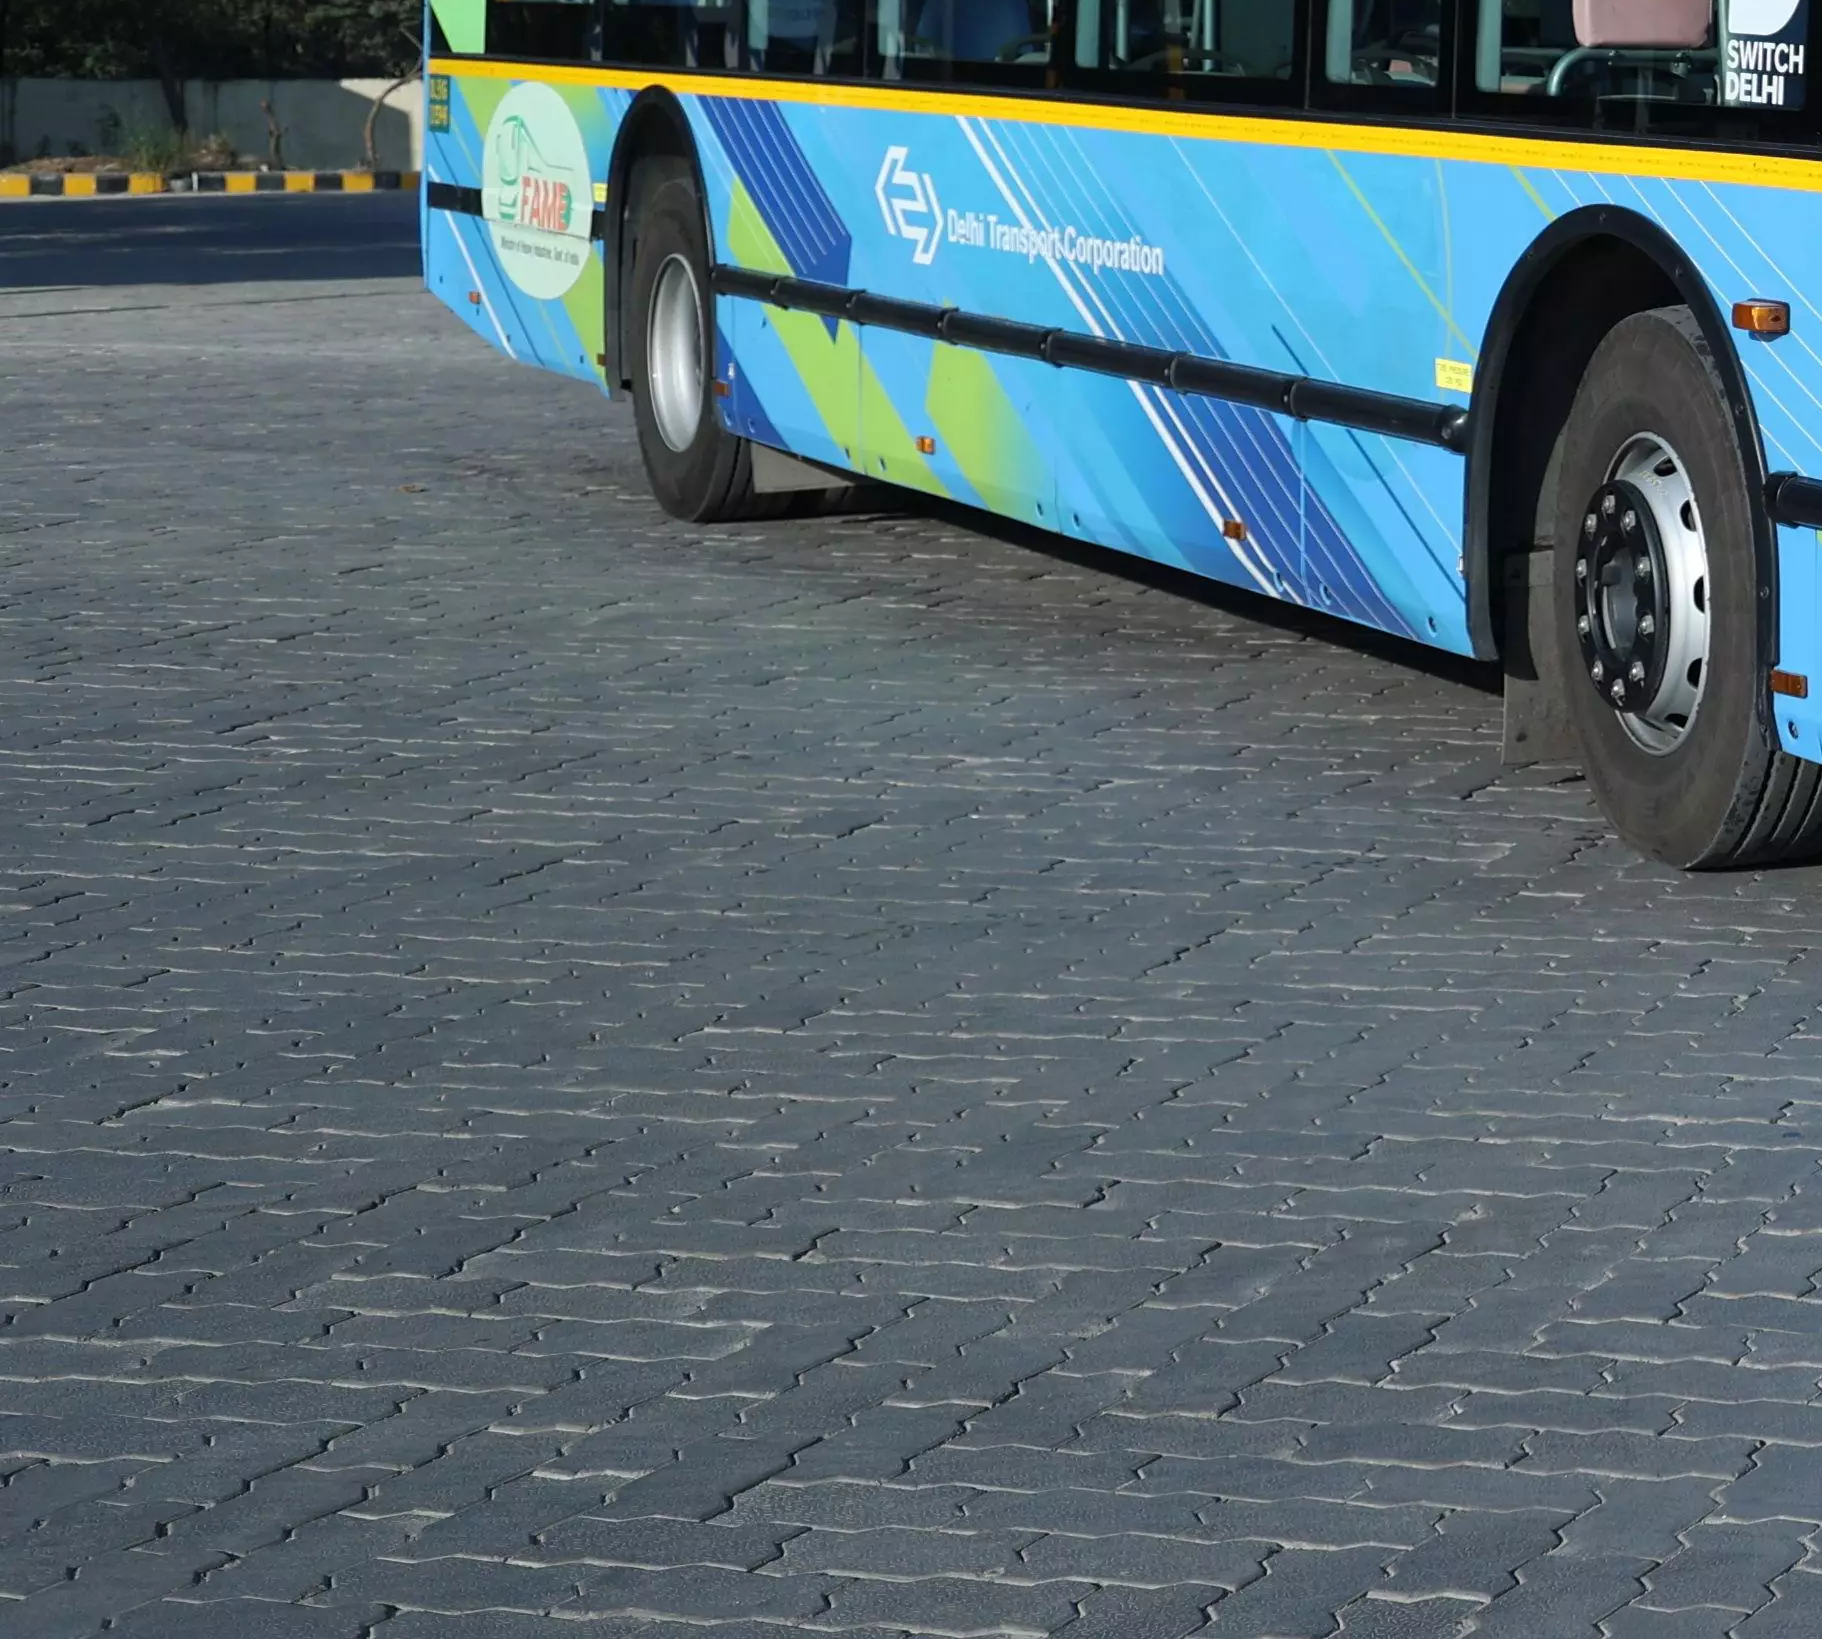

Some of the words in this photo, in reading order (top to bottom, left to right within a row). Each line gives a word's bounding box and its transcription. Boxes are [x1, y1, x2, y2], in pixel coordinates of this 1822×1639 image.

[1727, 40, 1804, 74] SWITCH
[1725, 72, 1785, 105] DELHI
[520, 175, 573, 232] FAME
[947, 208, 985, 247] Delhi
[987, 213, 1061, 264] Transport
[1063, 225, 1164, 275] Corporation
